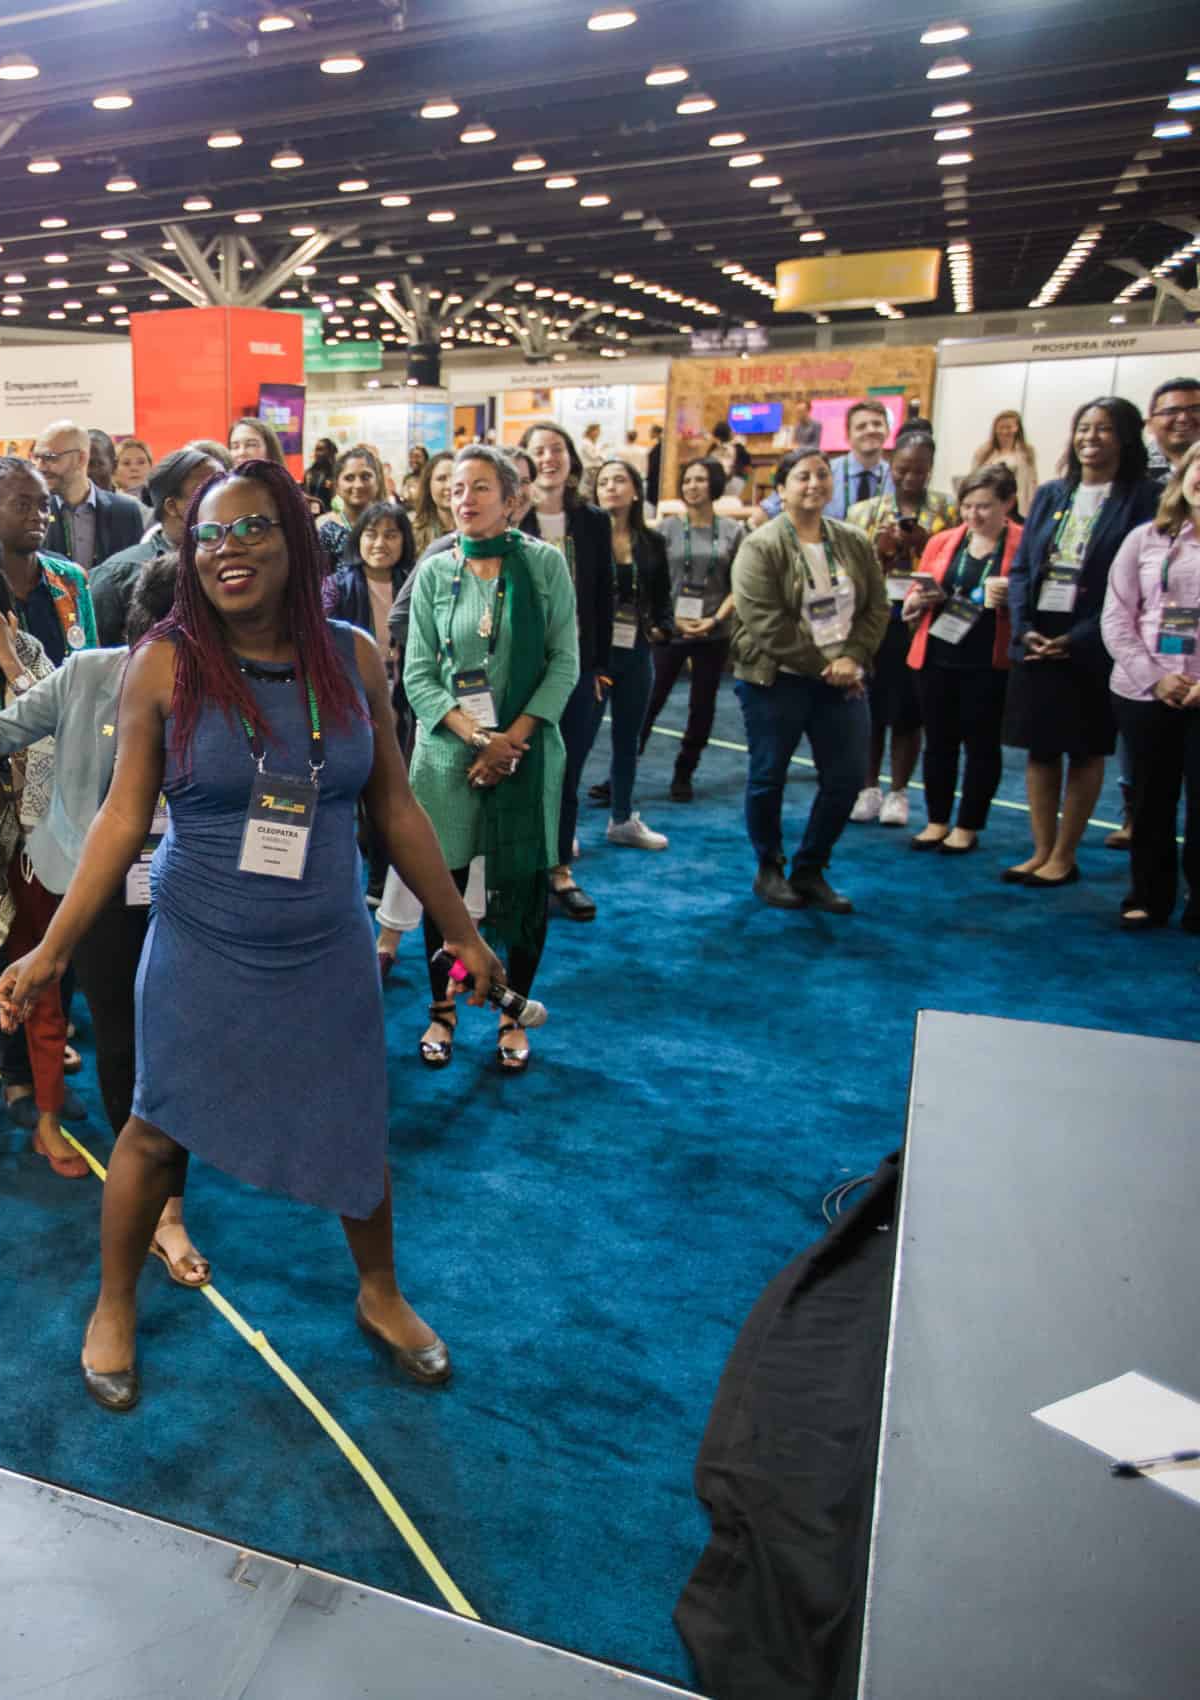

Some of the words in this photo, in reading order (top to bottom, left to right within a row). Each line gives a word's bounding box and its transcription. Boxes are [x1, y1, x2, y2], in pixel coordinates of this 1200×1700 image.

[1031, 342, 1098, 353] PROSPERA
[3, 379, 79, 393] Empowerment
[574, 397, 616, 411] CARE
[256, 825, 300, 840] CLEOPATRA
